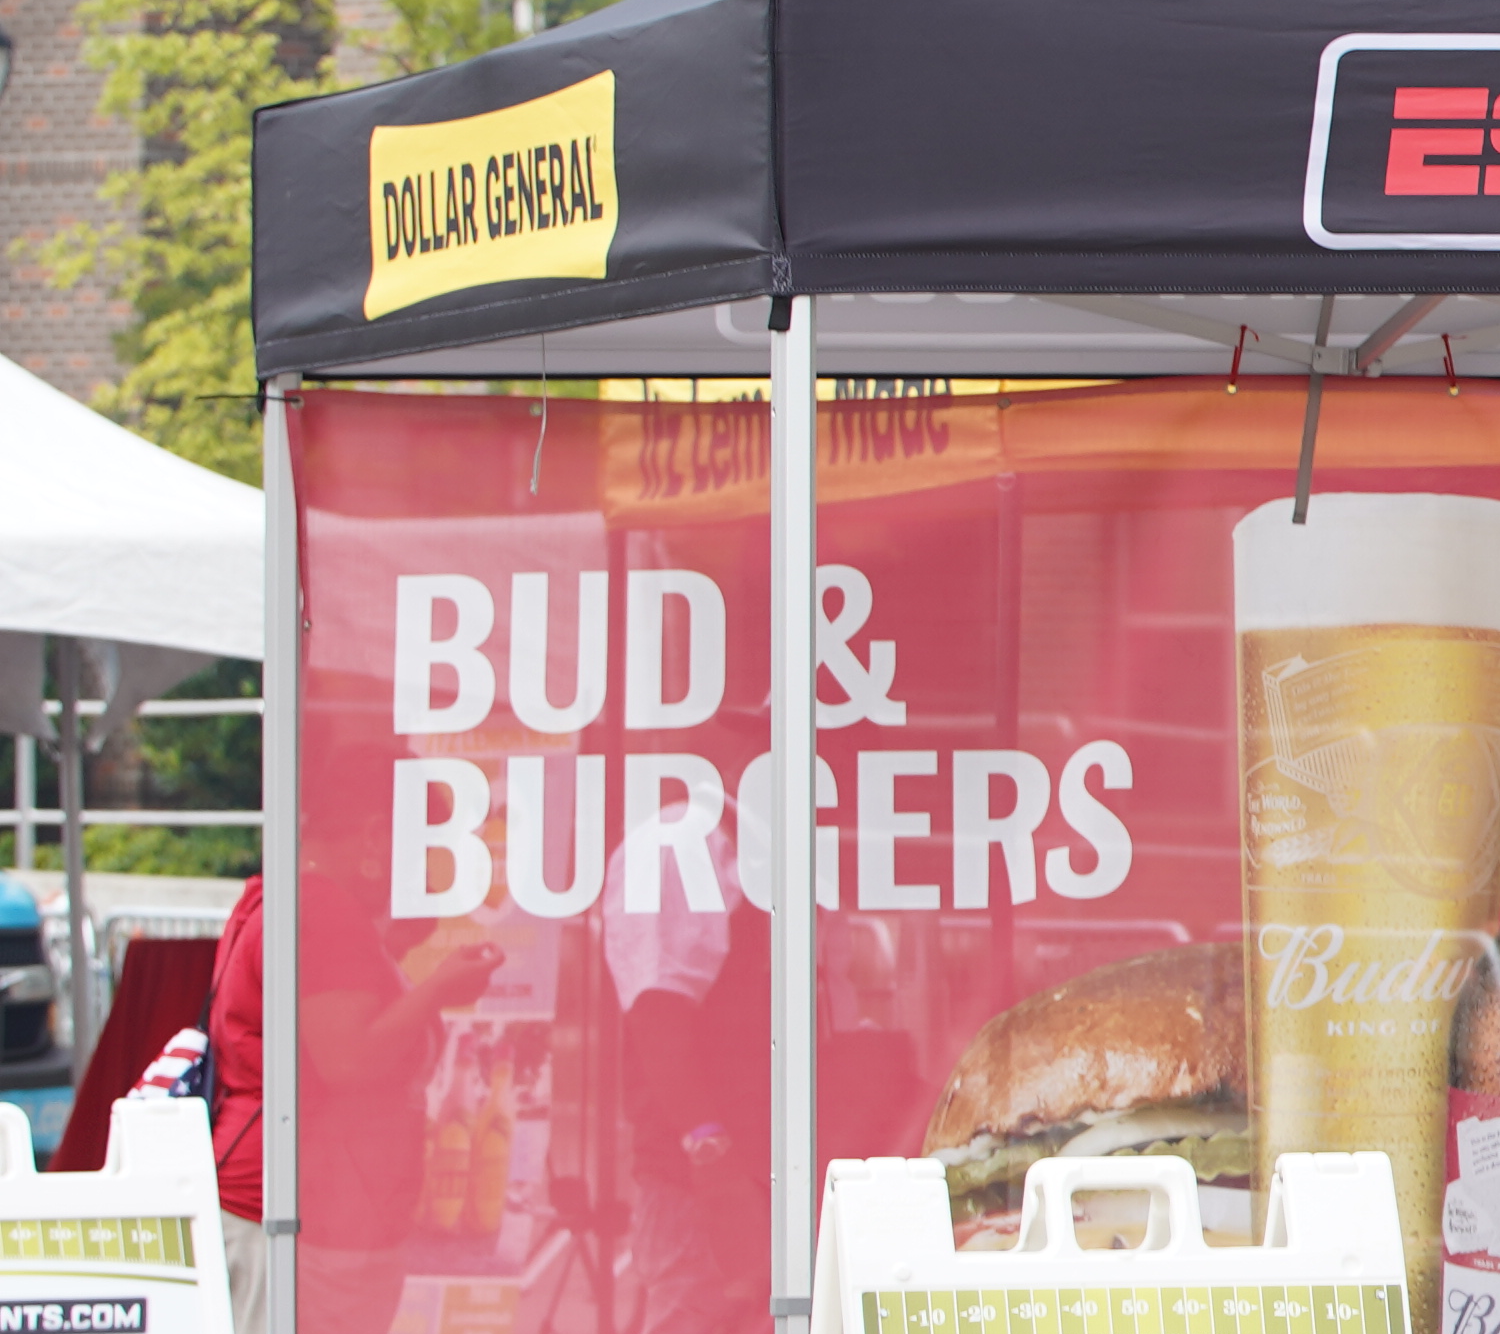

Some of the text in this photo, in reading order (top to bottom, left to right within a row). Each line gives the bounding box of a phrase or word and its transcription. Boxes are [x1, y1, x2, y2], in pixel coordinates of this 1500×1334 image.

[383, 136, 604, 262] DOLLAR GENERAL
[393, 563, 907, 736] BUD &
[390, 740, 1135, 920] BURGERS
